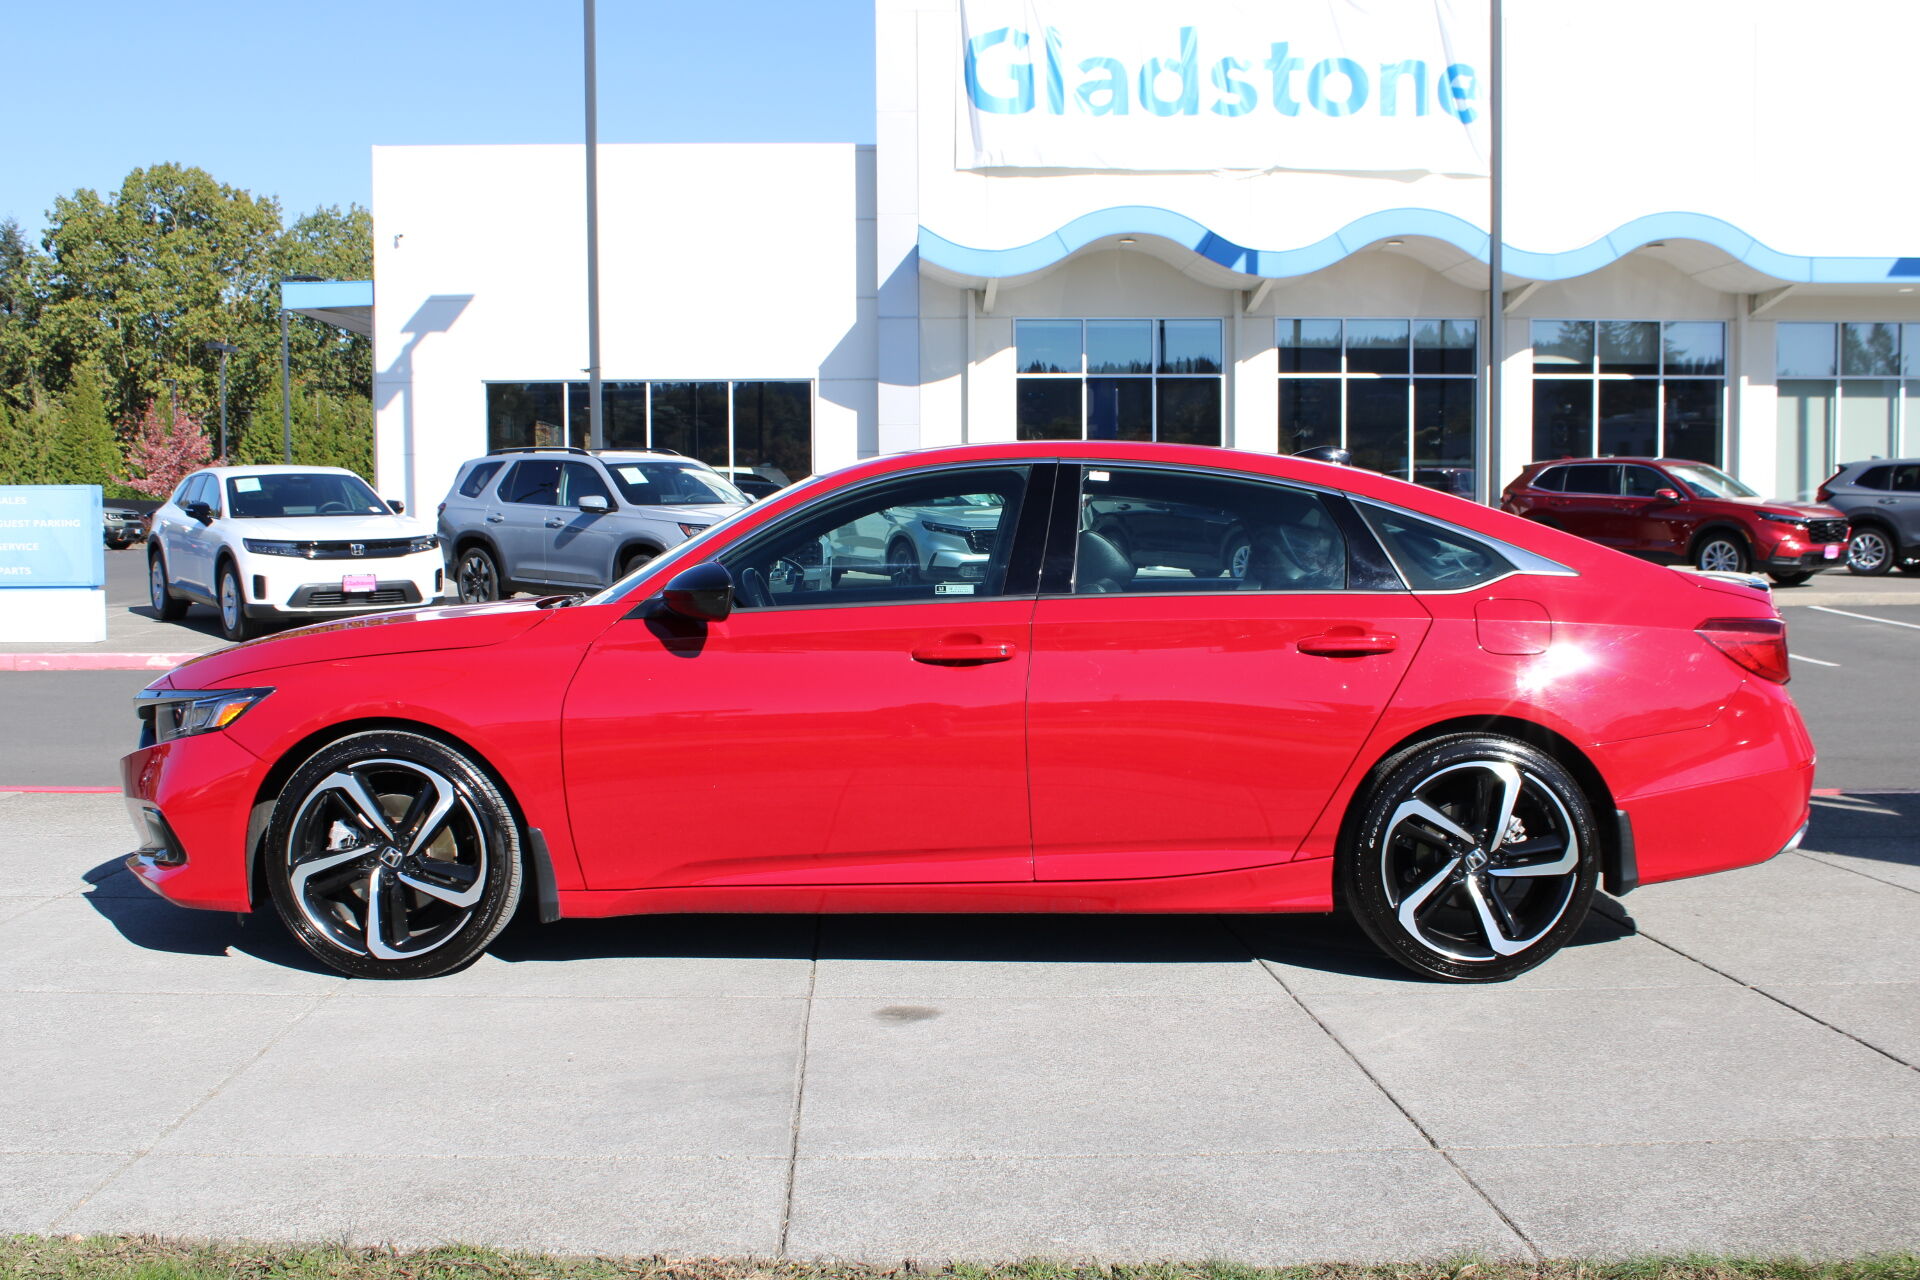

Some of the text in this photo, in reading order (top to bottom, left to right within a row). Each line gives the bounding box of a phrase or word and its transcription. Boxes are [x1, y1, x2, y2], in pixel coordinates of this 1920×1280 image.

[964, 25, 1479, 125] Gladstone
[0, 495, 27, 505] ALES
[32, 519, 81, 528] PARKING
[0, 542, 40, 551] ERVICE
